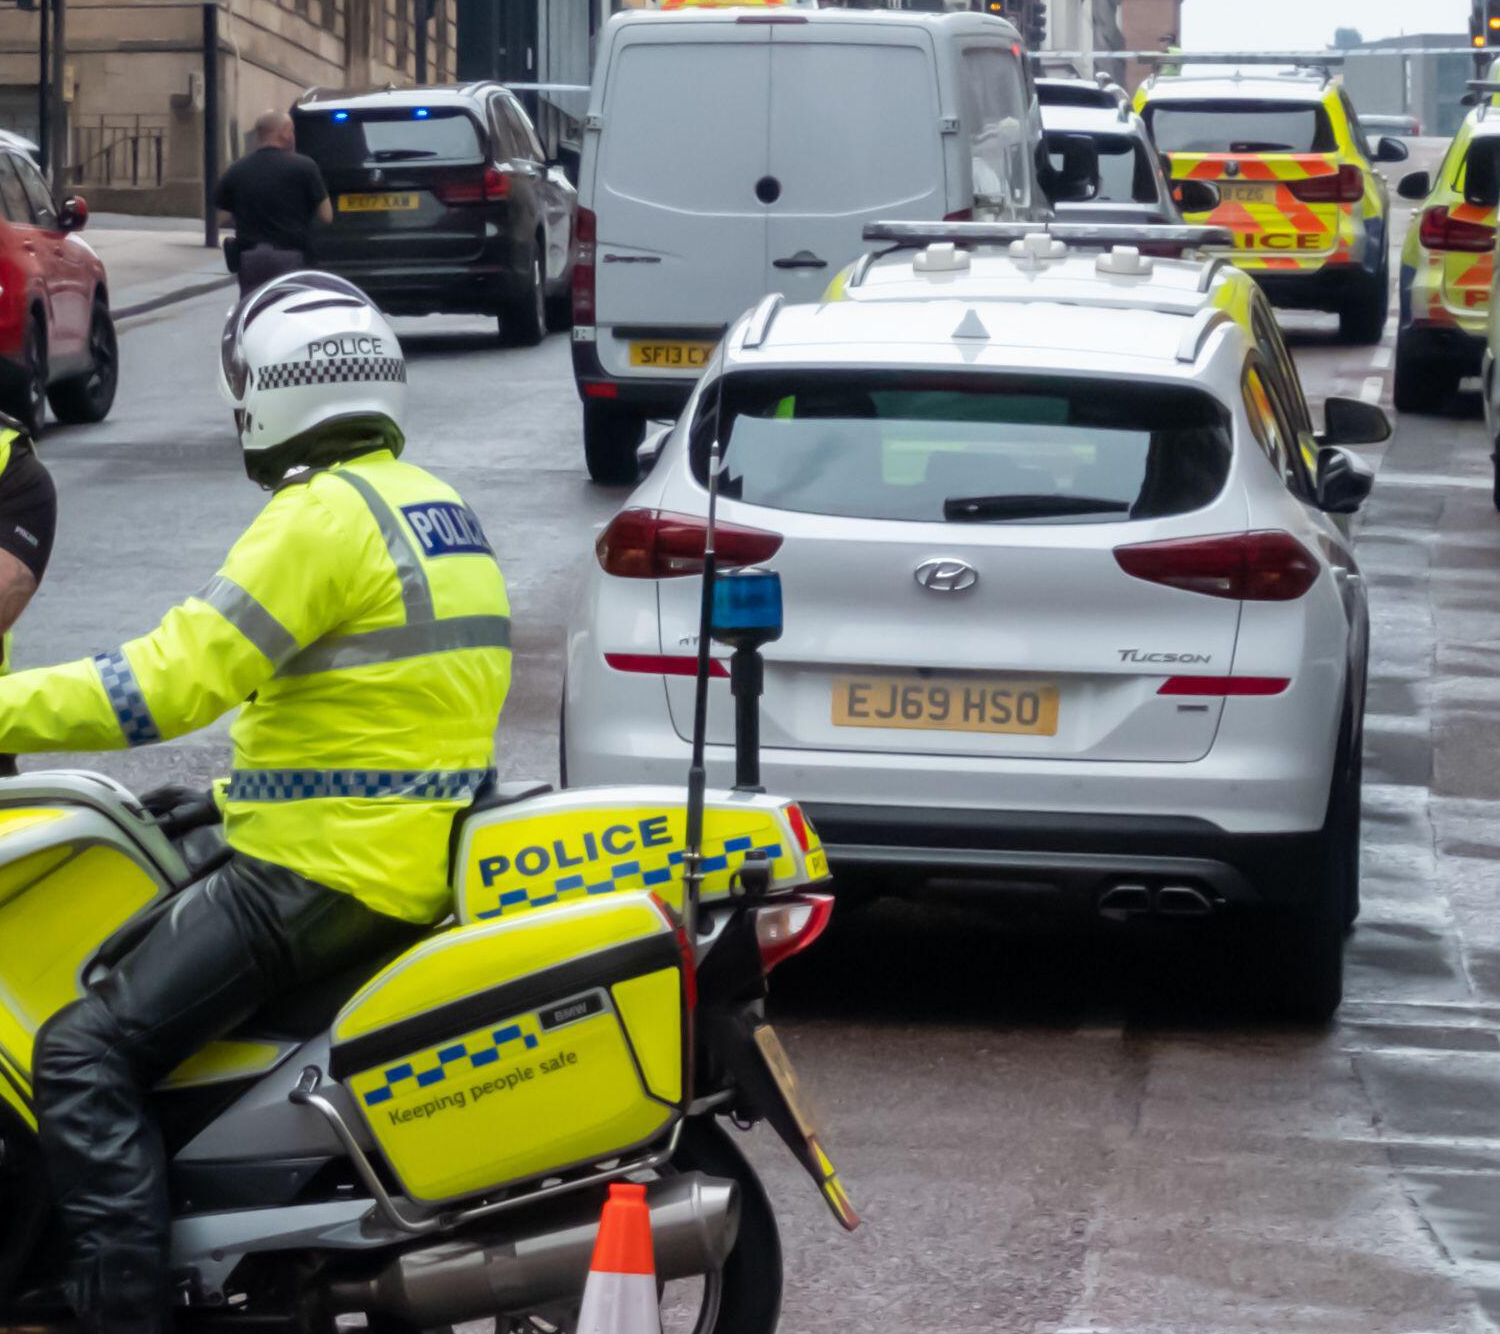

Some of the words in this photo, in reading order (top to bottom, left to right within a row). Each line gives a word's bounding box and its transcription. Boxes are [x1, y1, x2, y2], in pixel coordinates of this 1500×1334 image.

[1243, 232, 1320, 249] ICE
[307, 338, 384, 359] POLICE
[640, 347, 683, 364] SF13
[407, 507, 490, 549] POLIC
[847, 682, 951, 722] EJ69
[961, 687, 1041, 727] HSO
[479, 815, 673, 888] POLICE
[554, 1002, 588, 1022] BMW
[388, 1090, 467, 1126] Keeping
[470, 1065, 535, 1103] people
[539, 1049, 578, 1075] safe
